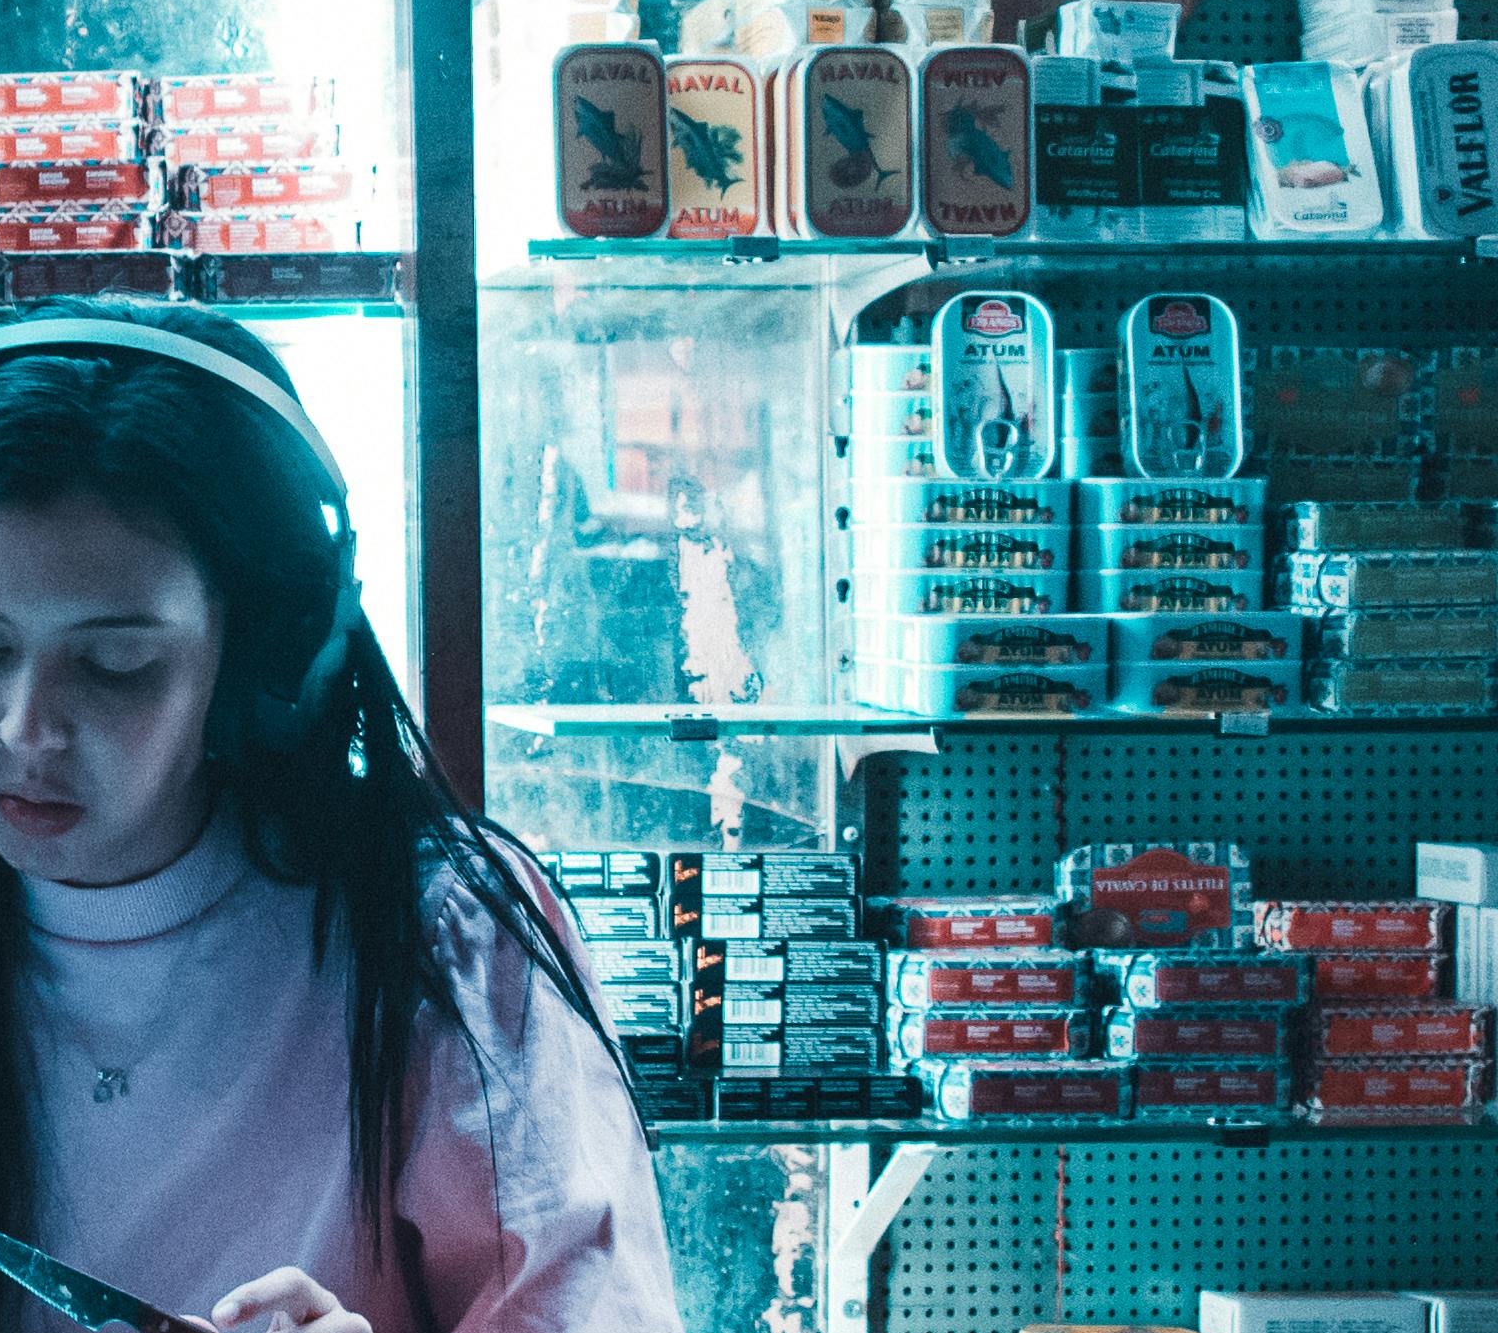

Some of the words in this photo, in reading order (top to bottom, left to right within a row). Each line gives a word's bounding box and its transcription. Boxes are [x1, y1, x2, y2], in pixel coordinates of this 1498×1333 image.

[819, 63, 900, 85] NAVAL
[1046, 142, 1115, 160] Catarina
[1448, 70, 1494, 219] VALFLOR
[584, 198, 648, 215] ATUM
[677, 207, 740, 226] ATUM
[963, 343, 1026, 358] ATUM
[1151, 345, 1210, 359] ATUM
